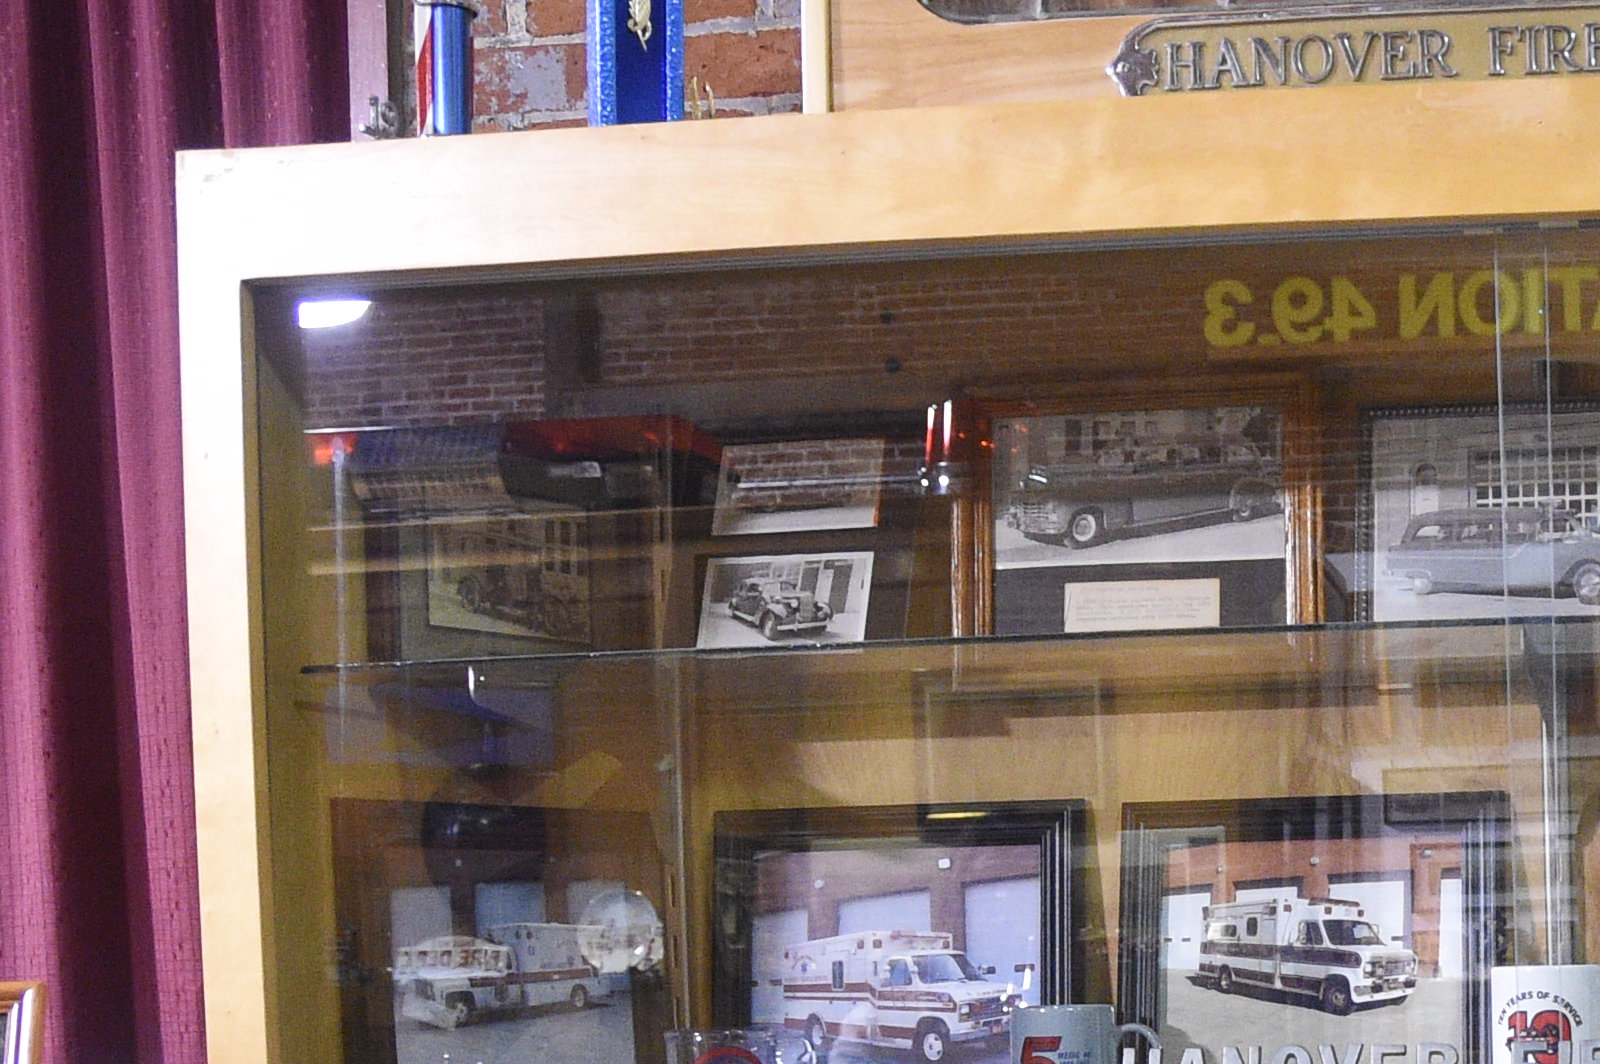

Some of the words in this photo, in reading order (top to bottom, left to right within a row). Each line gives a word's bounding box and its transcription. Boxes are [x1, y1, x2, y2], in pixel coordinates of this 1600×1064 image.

[1163, 29, 1457, 92] HANOVER
[1506, 991, 1534, 1008] YEARS
[1537, 990, 1550, 999] OF
[1553, 995, 1583, 1027] SERVICE
